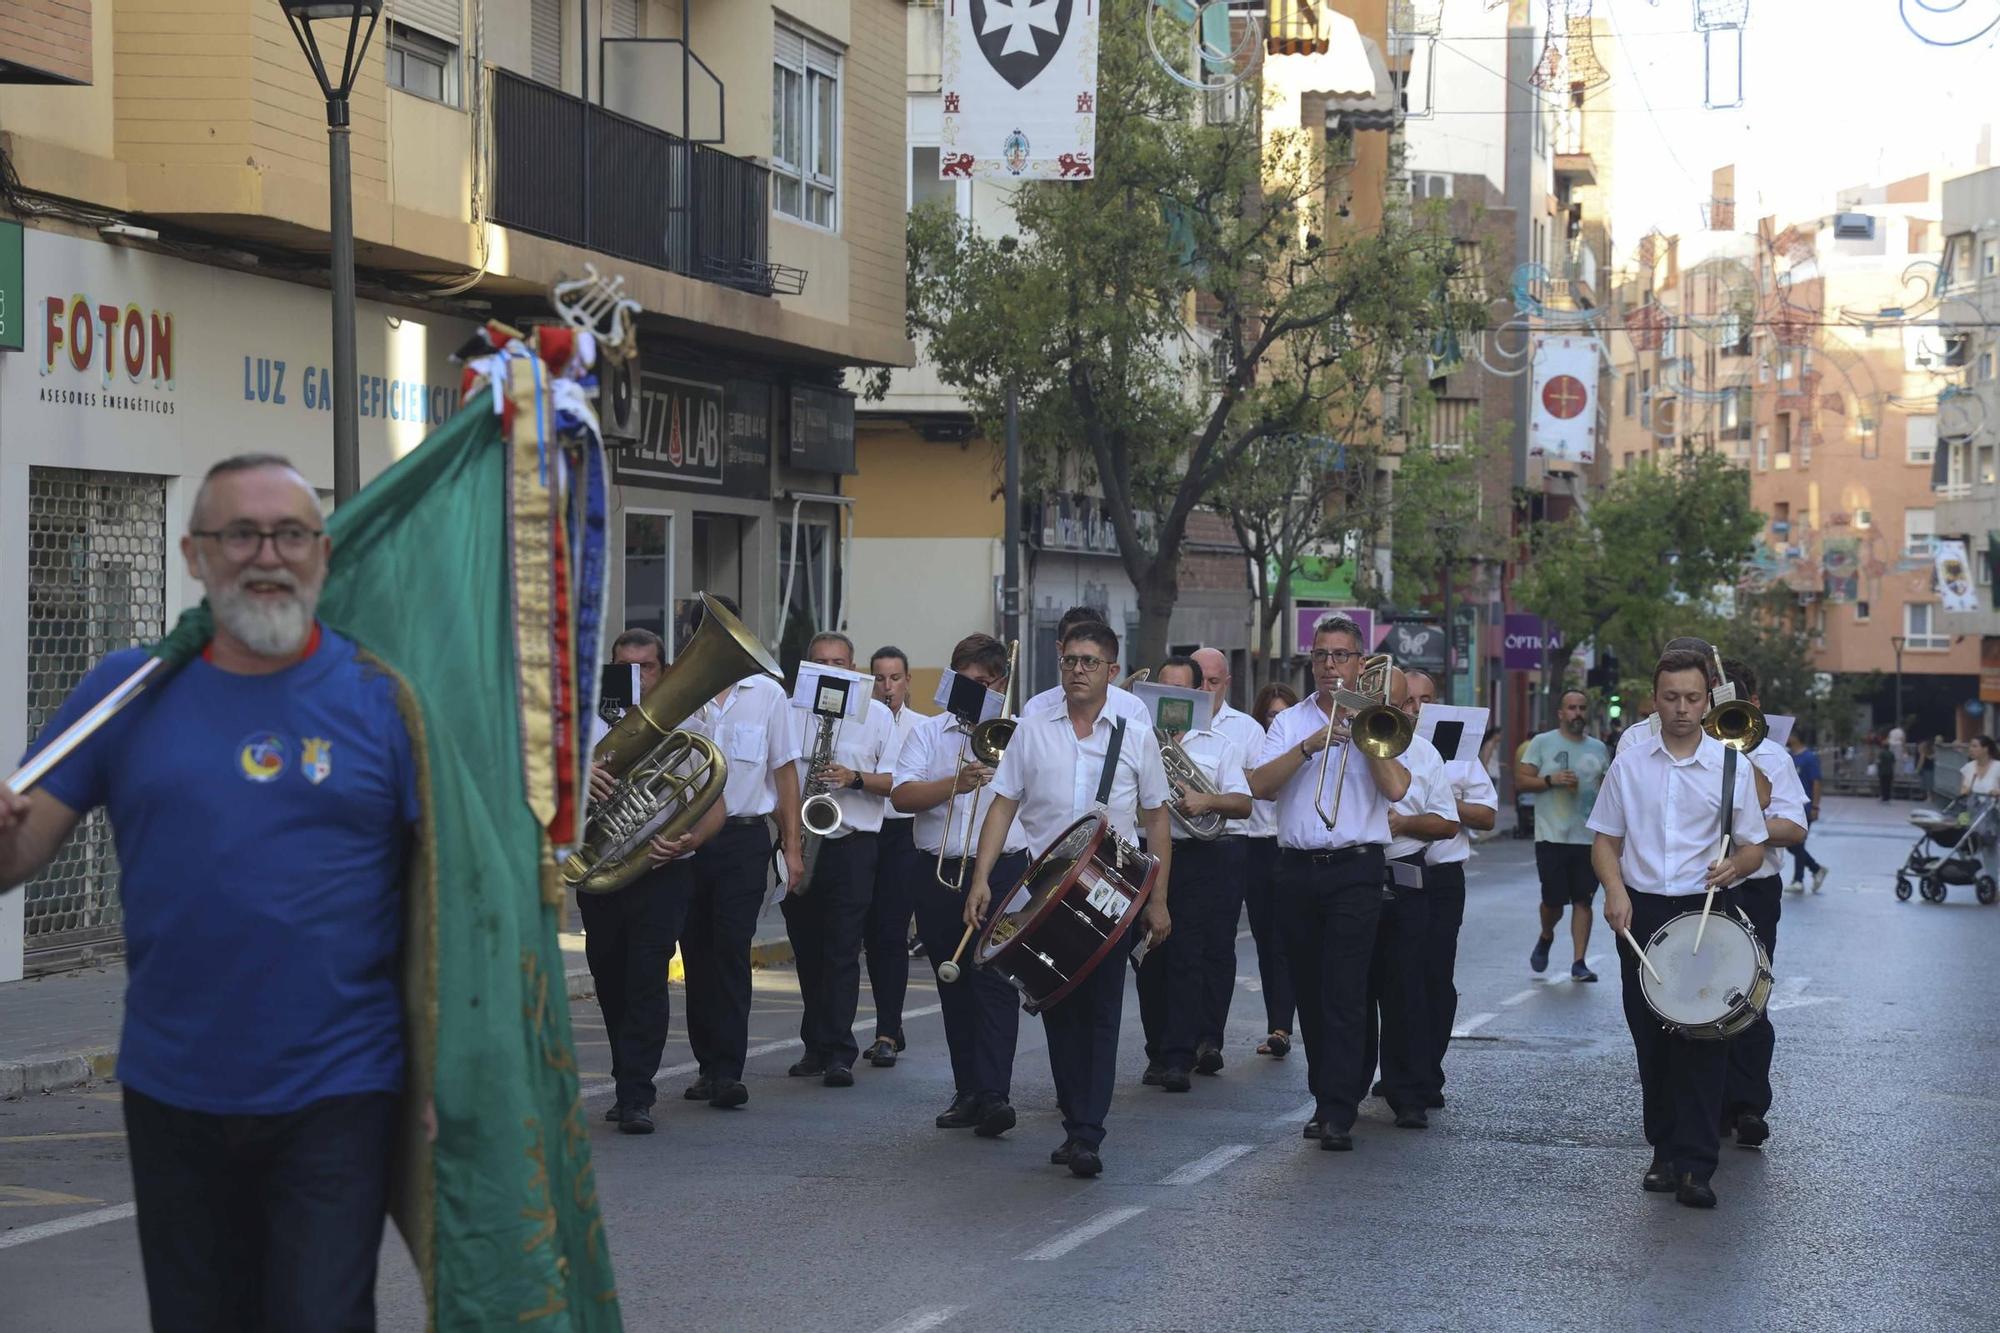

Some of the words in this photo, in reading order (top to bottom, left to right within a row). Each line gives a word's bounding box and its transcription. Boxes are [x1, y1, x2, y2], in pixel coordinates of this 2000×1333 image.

[40, 293, 175, 391] FOTON
[40, 387, 96, 407] ASESORES
[102, 394, 175, 415] ENERGÉTICOS
[244, 356, 286, 405] LUZ
